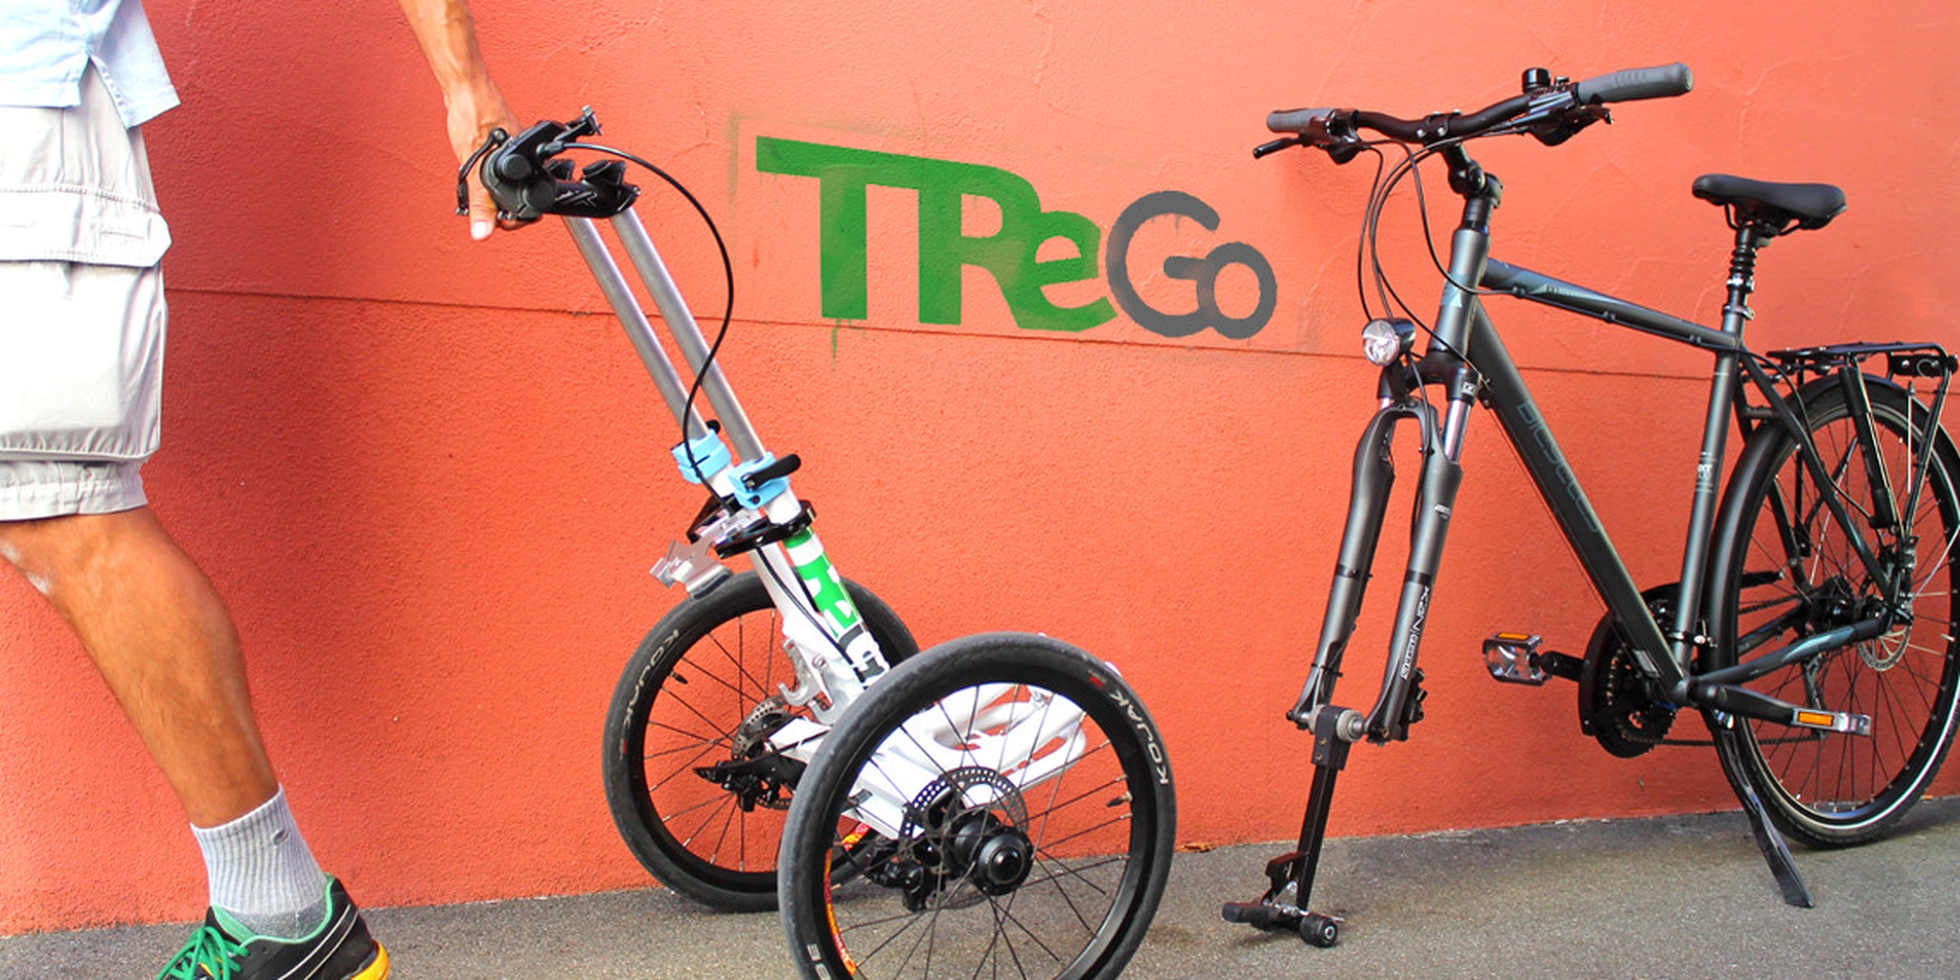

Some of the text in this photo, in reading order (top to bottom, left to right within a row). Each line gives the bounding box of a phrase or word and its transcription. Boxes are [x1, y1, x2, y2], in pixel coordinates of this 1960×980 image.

[756, 136, 1277, 339] TReGo
[620, 629, 679, 728] KOJAK
[1109, 690, 1169, 784] KOJAK
